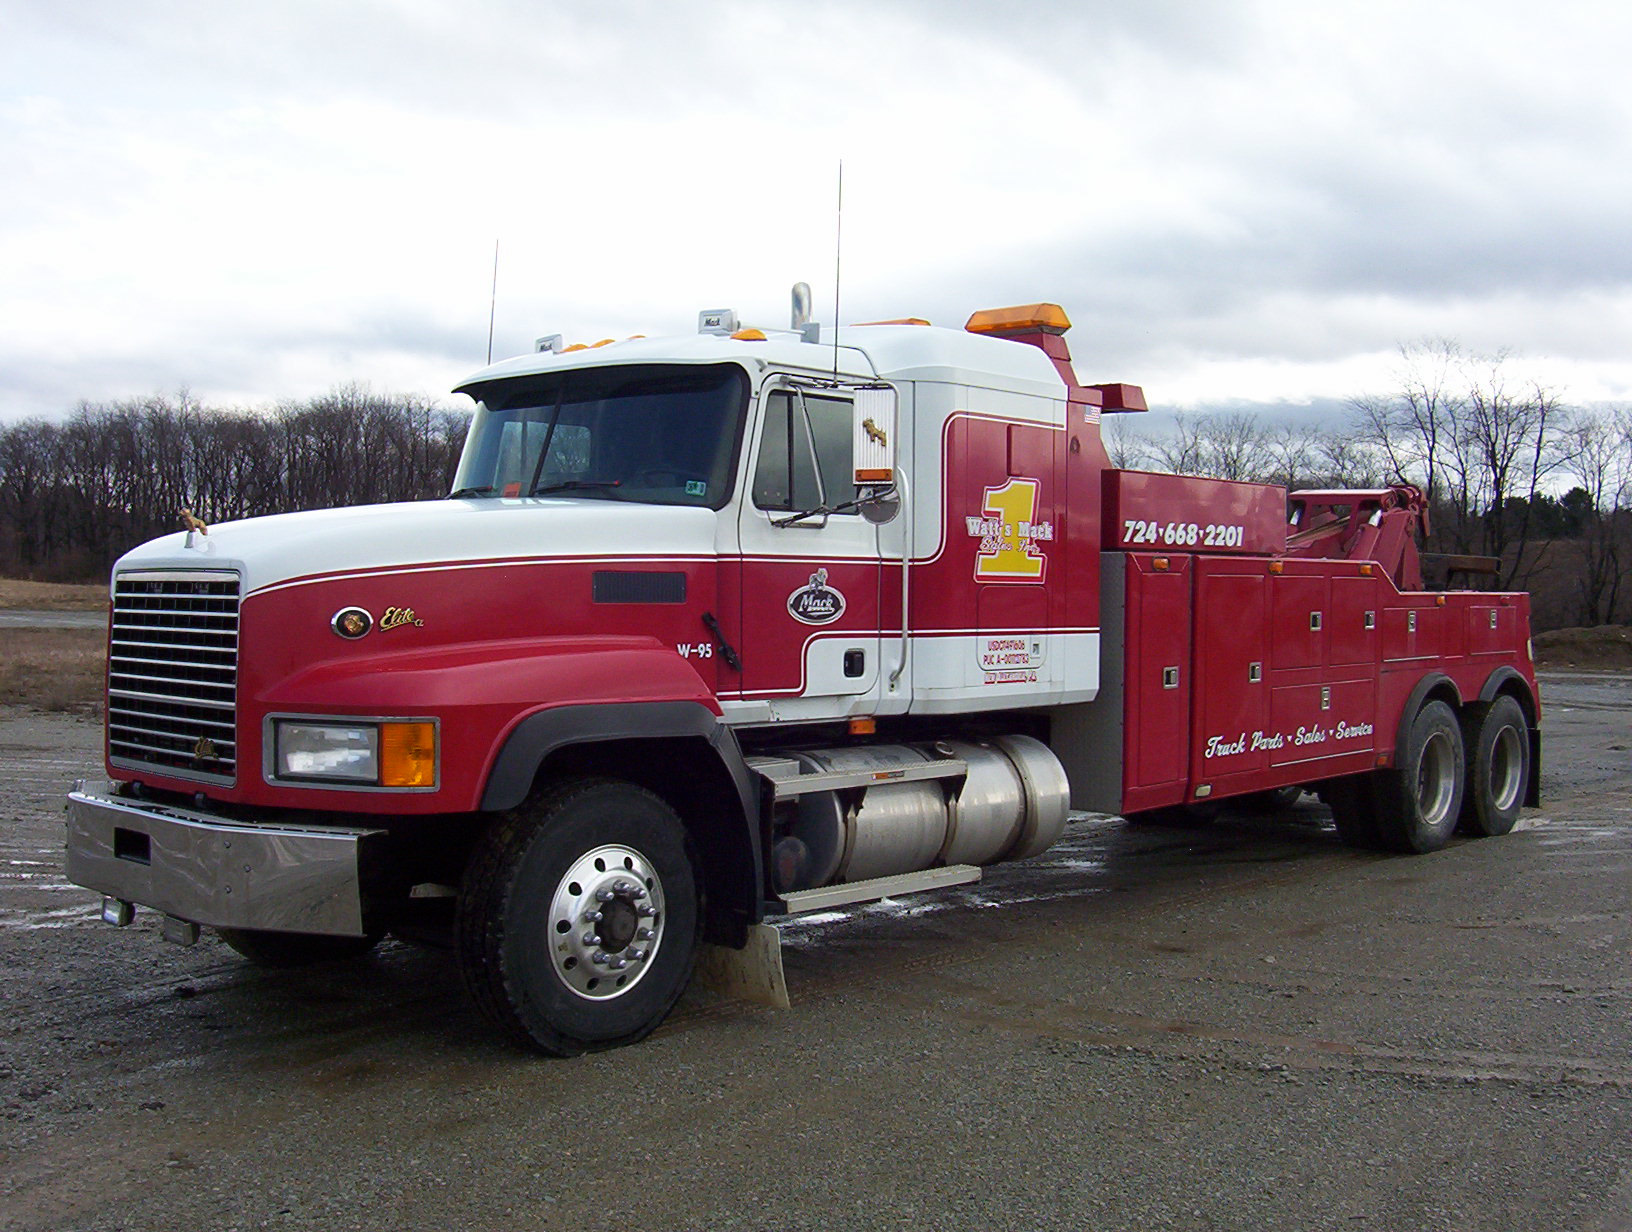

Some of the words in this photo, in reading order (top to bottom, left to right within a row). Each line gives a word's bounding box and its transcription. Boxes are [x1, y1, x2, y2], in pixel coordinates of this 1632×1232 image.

[1018, 521, 1053, 540] Mack
[798, 593, 836, 615] Mack
[379, 606, 415, 632] Elite
[676, 643, 713, 659] W-95
[1204, 733, 1247, 759] Truck
[1250, 730, 1284, 752] Parts
[1294, 724, 1326, 746] Sales
[1335, 720, 1374, 740] Service
